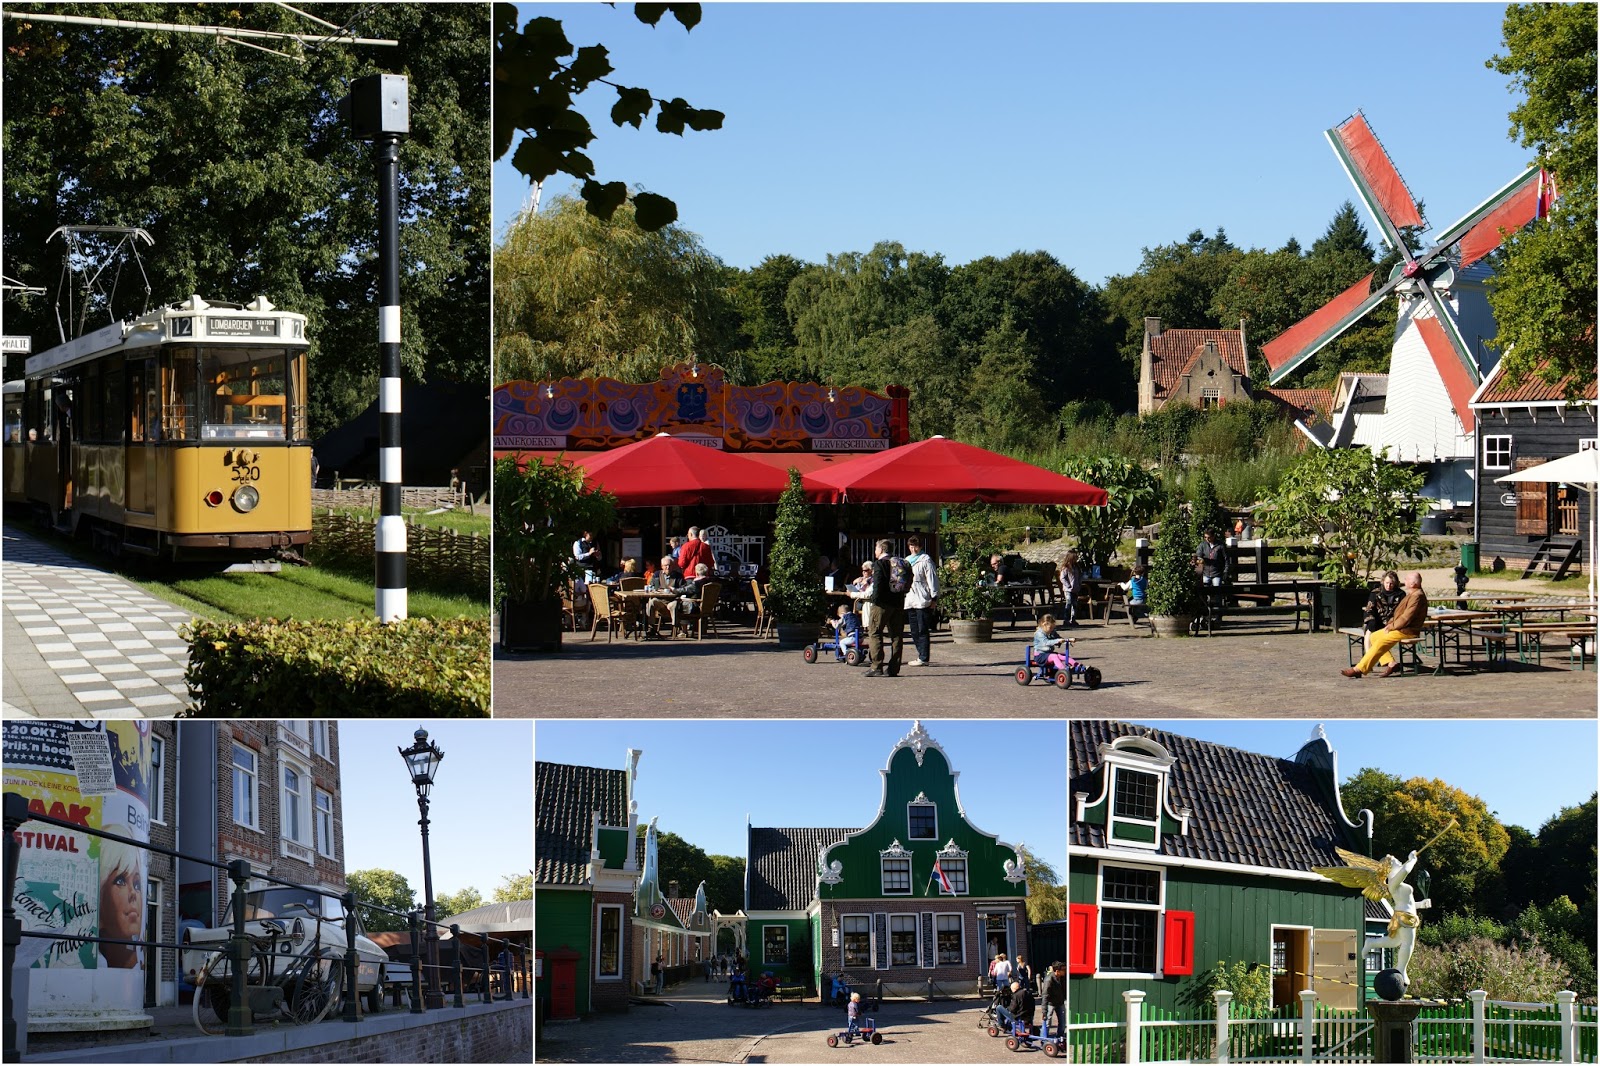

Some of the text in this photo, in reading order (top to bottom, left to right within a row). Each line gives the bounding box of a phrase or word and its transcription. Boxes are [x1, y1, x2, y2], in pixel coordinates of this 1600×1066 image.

[174, 318, 191, 335] 12
[813, 440, 886, 449] VERVERSCHINGEN
[231, 466, 260, 481] 520
[30, 726, 59, 739] OKT.
[39, 781, 62, 790] KLEINE
[28, 799, 91, 828] AAK
[13, 831, 79, 853] STIVAL
